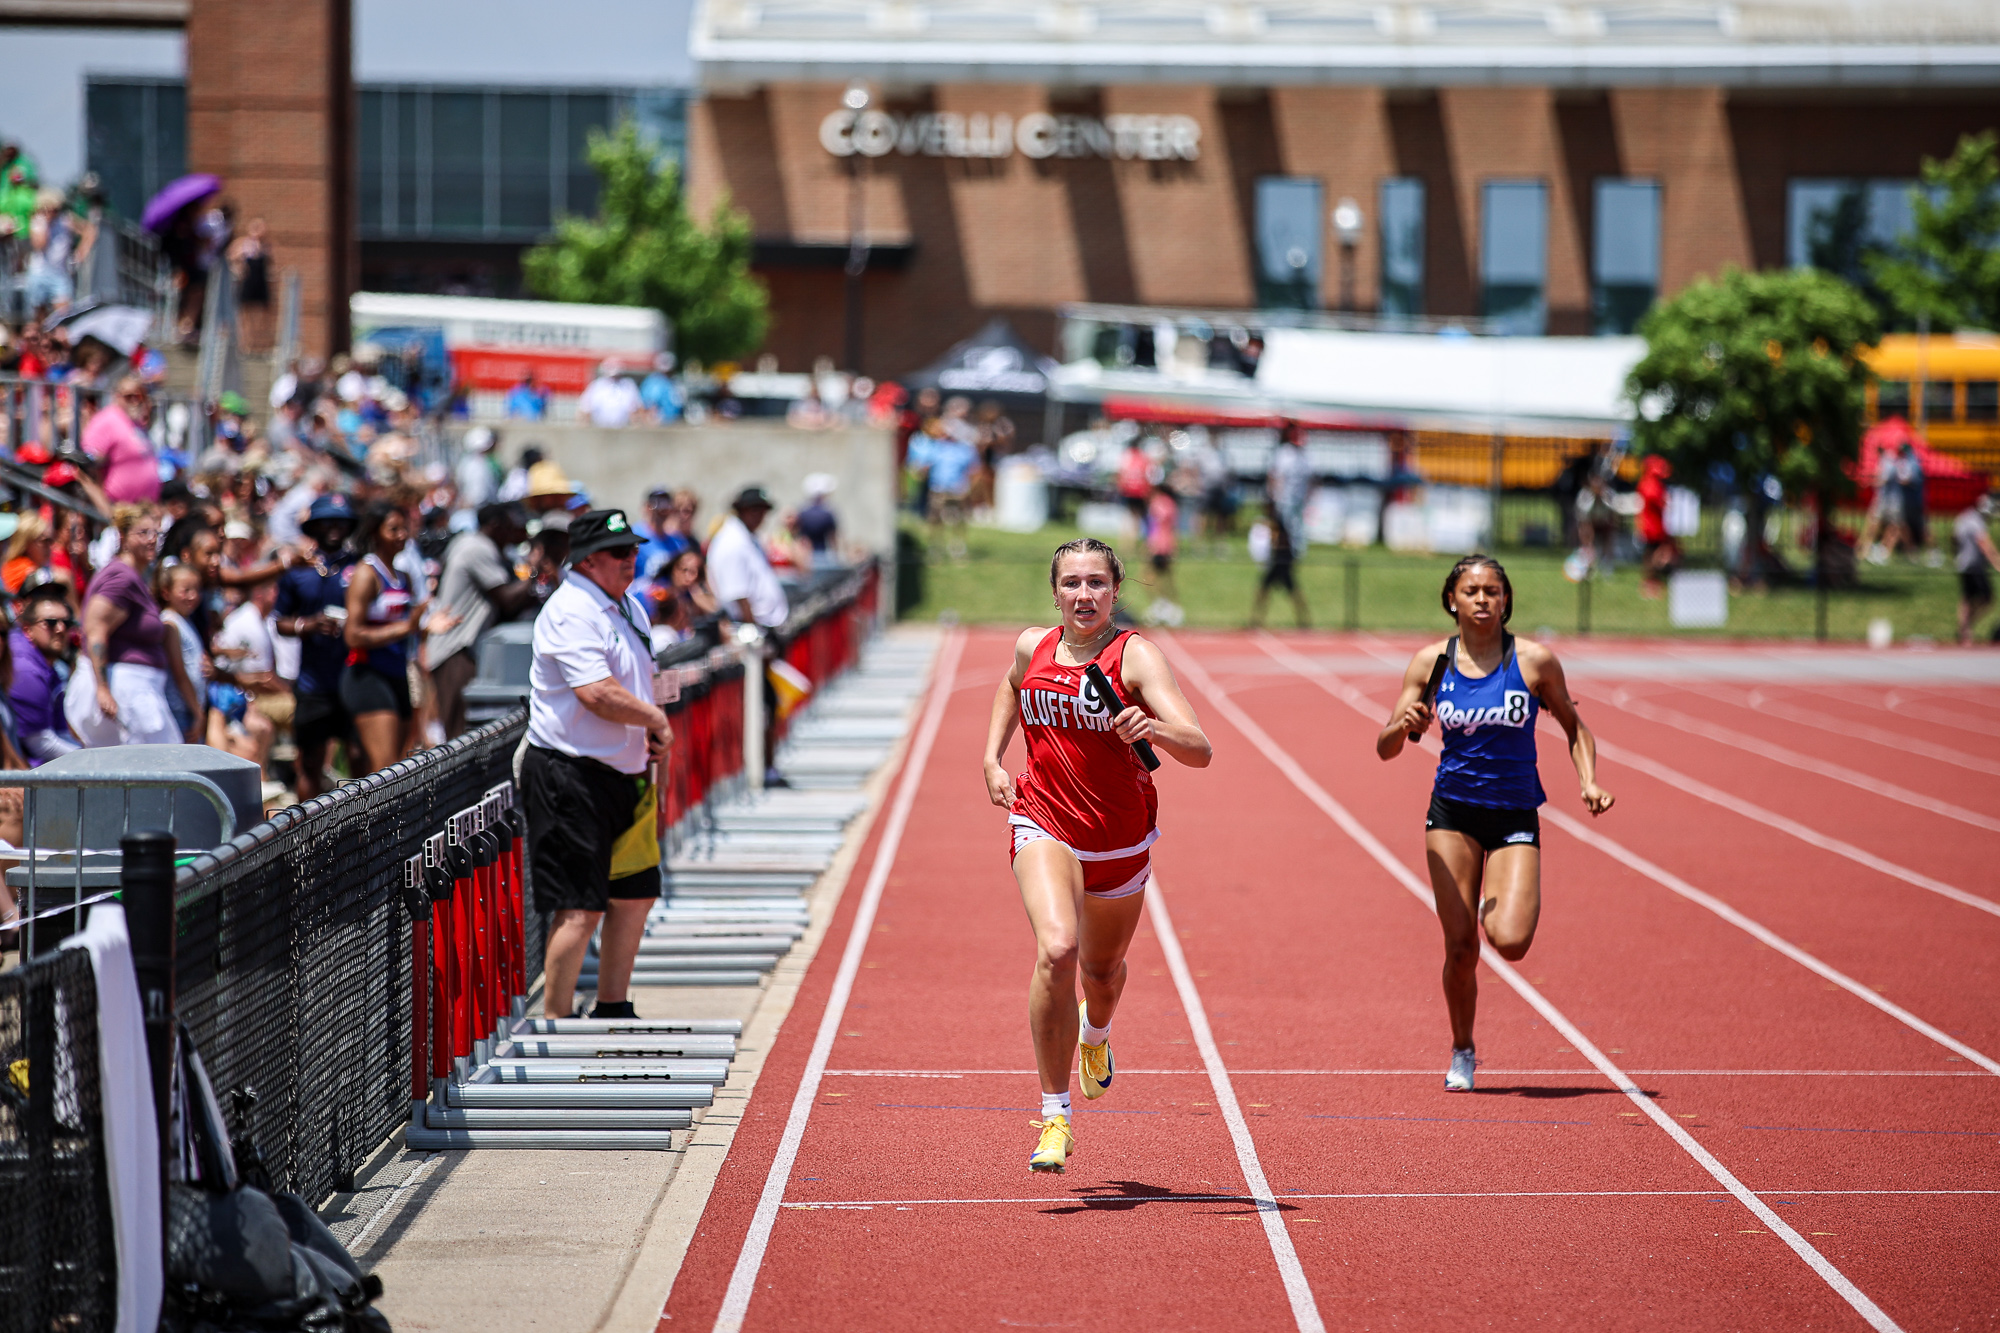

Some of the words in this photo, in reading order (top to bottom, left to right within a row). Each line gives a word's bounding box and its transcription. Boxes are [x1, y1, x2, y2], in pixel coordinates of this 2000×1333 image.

[819, 109, 1013, 157] COVELLI
[1016, 112, 1201, 160] CENTER
[1084, 678, 1107, 714] 9
[1508, 694, 1525, 724] 8
[1437, 700, 1531, 737] Roya
